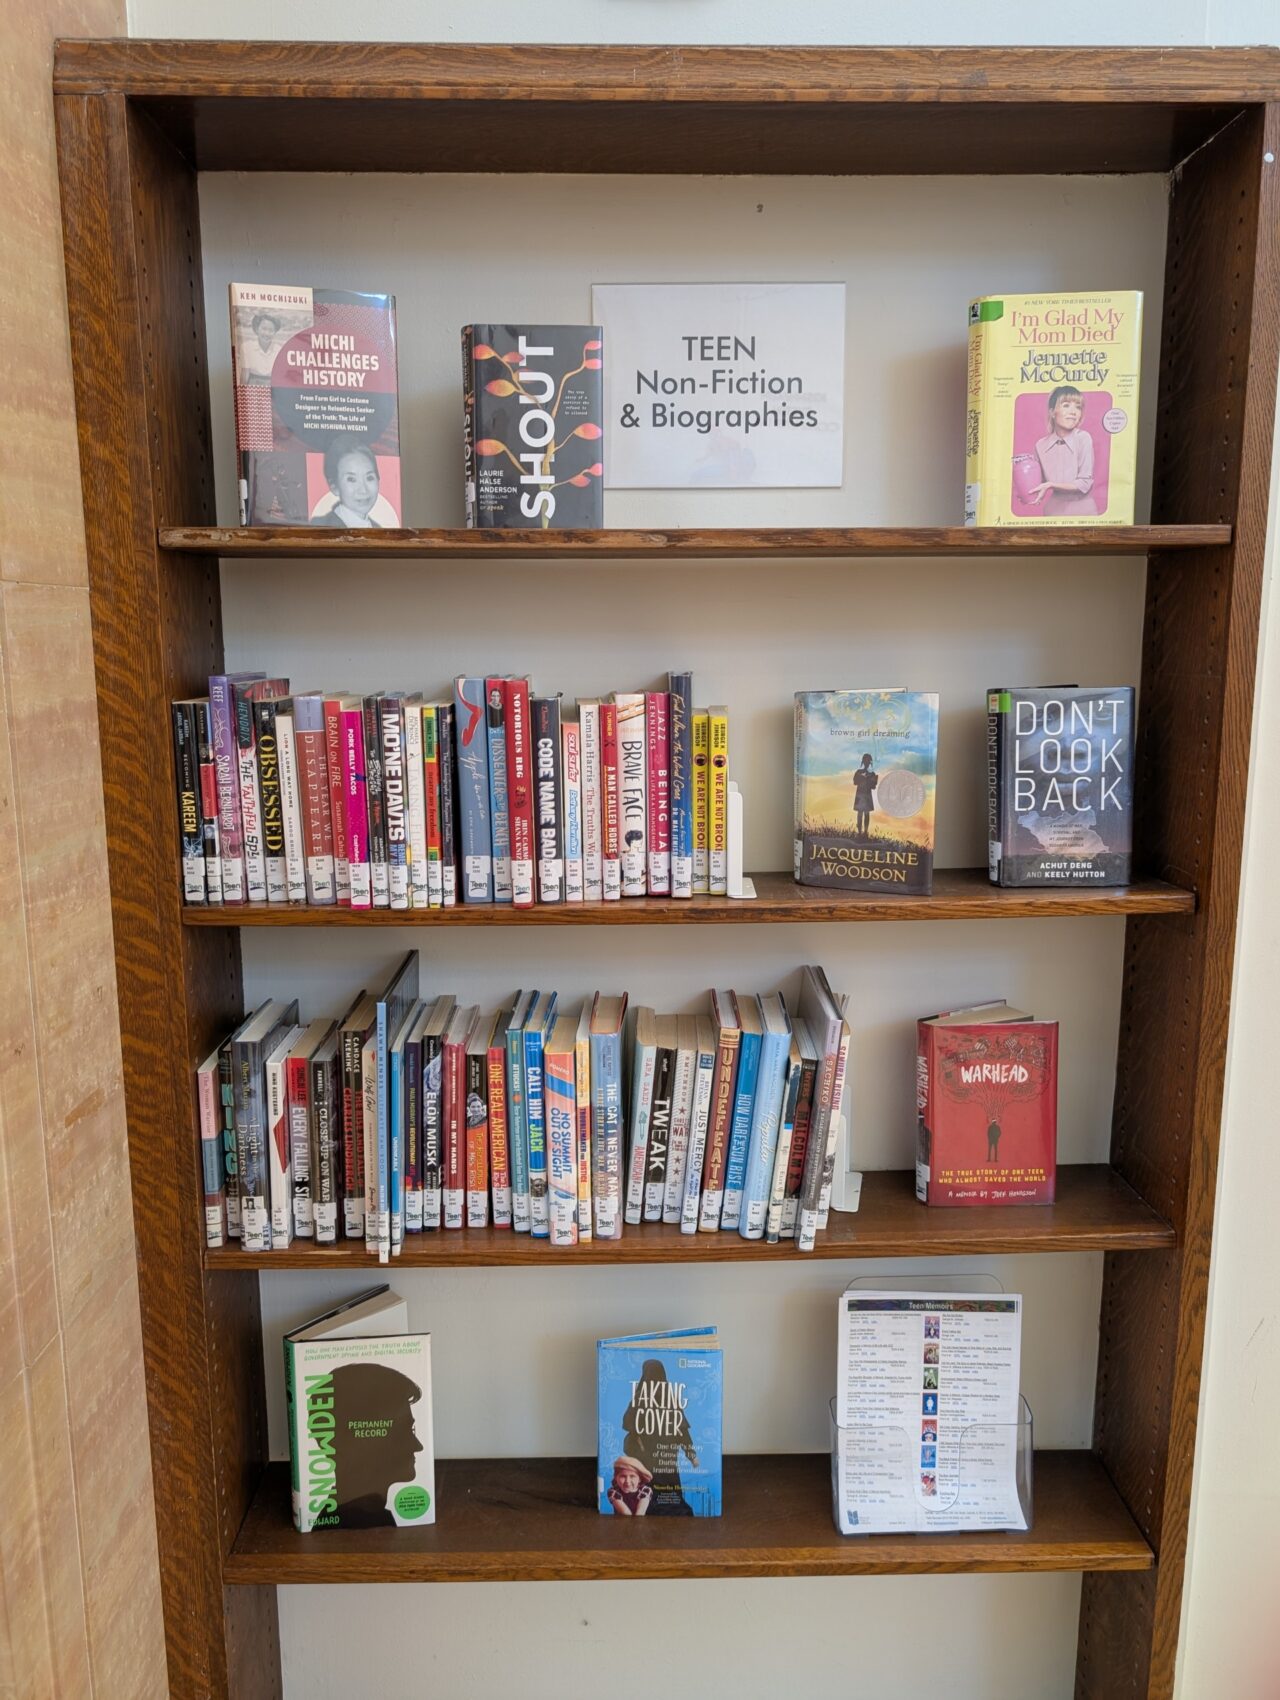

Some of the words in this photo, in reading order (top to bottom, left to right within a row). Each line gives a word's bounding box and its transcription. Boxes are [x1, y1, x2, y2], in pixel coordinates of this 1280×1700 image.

[240, 292, 256, 301] KEN
[260, 294, 308, 304] MOCHIZUKI
[1011, 310, 1039, 327] I'm
[1045, 309, 1088, 326] Glad
[1094, 308, 1124, 330] My
[311, 333, 354, 352] MICHI
[682, 336, 756, 361] TEEN
[1019, 328, 1066, 344] Mom
[1072, 326, 1114, 343] Died
[286, 351, 379, 370] CHALLENGES
[1023, 350, 1107, 368] Jennette
[303, 370, 366, 388] HISTORY
[637, 369, 802, 394] Non-Fiction
[1020, 366, 1110, 386] McCurdy
[518, 336, 555, 519] SHOUT
[620, 403, 640, 428] &
[652, 401, 818, 434] Biographies
[213, 686, 224, 702] REEF
[238, 702, 250, 742] HENDRIX
[328, 716, 337, 748] BRAIN
[513, 693, 523, 753] NOTORIOUS
[585, 711, 594, 748] Kamala
[1016, 700, 1124, 736] DON'T
[383, 714, 400, 777] MO'NE
[567, 733, 578, 753] soul
[857, 729, 871, 738] girl
[873, 729, 910, 738] dreaming
[988, 716, 998, 756] DON'T
[216, 755, 230, 784] SARAH
[318, 756, 328, 779] THE
[492, 739, 506, 795] DISSENTER
[515, 757, 523, 778] RBG
[538, 738, 554, 778] CODE
[568, 754, 578, 782] surfer
[586, 751, 595, 782] Harris
[622, 741, 642, 782] BRAVE
[1015, 738, 1124, 774] LOOK
[331, 766, 340, 788] FIRE
[697, 771, 705, 784] WE
[715, 772, 723, 786] WE
[988, 760, 998, 796] LOOK
[260, 735, 282, 850] OBSESSED
[320, 785, 330, 816] YEAR
[428, 796, 434, 806] my
[539, 781, 555, 825] NAME
[569, 789, 578, 820] Bethany
[586, 787, 595, 805] The
[622, 789, 643, 820] FACE
[658, 770, 667, 821] BEING
[697, 787, 705, 803] ARE
[716, 788, 724, 804] ARE
[1014, 777, 1123, 812] BACK
[182, 792, 197, 832] KAREEM
[220, 786, 234, 831] BERNHARDT
[386, 779, 405, 840] DAVIS
[608, 794, 616, 824] CALLED
[715, 807, 723, 821] NOT
[988, 798, 998, 833] BACK
[324, 822, 332, 841] WE
[494, 812, 509, 847] BENCH
[569, 820, 578, 854] Hamilton
[587, 807, 596, 839] Truths
[697, 822, 706, 850] BROKE
[608, 827, 617, 853] HORSE
[659, 831, 668, 850] JA
[810, 844, 919, 865] JACQUELINE
[820, 861, 906, 882] WOODSON
[490, 1064, 502, 1084] ONE
[512, 1064, 520, 1092] ATTUCKS!
[835, 1046, 846, 1082] SAMURAI
[961, 1063, 1028, 1084] WARHEAD
[528, 1066, 541, 1094] CALL
[607, 1082, 617, 1102] THE
[822, 1060, 833, 1103] SACHIKO
[916, 1056, 929, 1110] WARHEAD
[344, 1088, 353, 1132] CHARLES
[427, 1092, 437, 1124] ELON
[490, 1088, 503, 1113] REAL
[529, 1098, 542, 1120] HIM
[737, 1094, 752, 1114] HOW
[832, 1084, 842, 1110] RISING
[292, 1107, 307, 1138] EVERY
[451, 1120, 456, 1129] IN
[551, 1108, 560, 1132] OUT
[562, 1113, 570, 1129] NO
[608, 1106, 617, 1124] CAT
[698, 1109, 707, 1134] JUST
[734, 1116, 750, 1138] DARE
[319, 1108, 328, 1159] CLOSE-UP
[427, 1128, 437, 1166] MUSK
[452, 1132, 456, 1144] MY
[492, 1118, 506, 1170] AMERICAN
[530, 1123, 544, 1152] JACK
[552, 1134, 561, 1146] OF
[649, 1100, 670, 1170] TWEAK
[238, 1124, 248, 1175] Darkness
[294, 1142, 309, 1181] FALLING
[345, 1134, 354, 1190] LINDBERGH
[552, 1148, 562, 1179] SIGHT
[563, 1131, 572, 1173] SUMMIT
[608, 1137, 618, 1171] NEVER
[694, 1138, 704, 1174] MERCY
[731, 1146, 747, 1164] SUN
[320, 1161, 329, 1176] ON
[728, 1166, 743, 1184] RISE
[321, 1178, 329, 1201] WAR
[926, 1302, 953, 1310] Memoirs
[629, 1380, 688, 1410] TAKING
[348, 1420, 393, 1430] PERMANENT
[354, 1429, 388, 1438] RECORD
[635, 1408, 684, 1437] COVER
[304, 1374, 338, 1514] SNOWDEN
[308, 1516, 340, 1526] EDWARD
